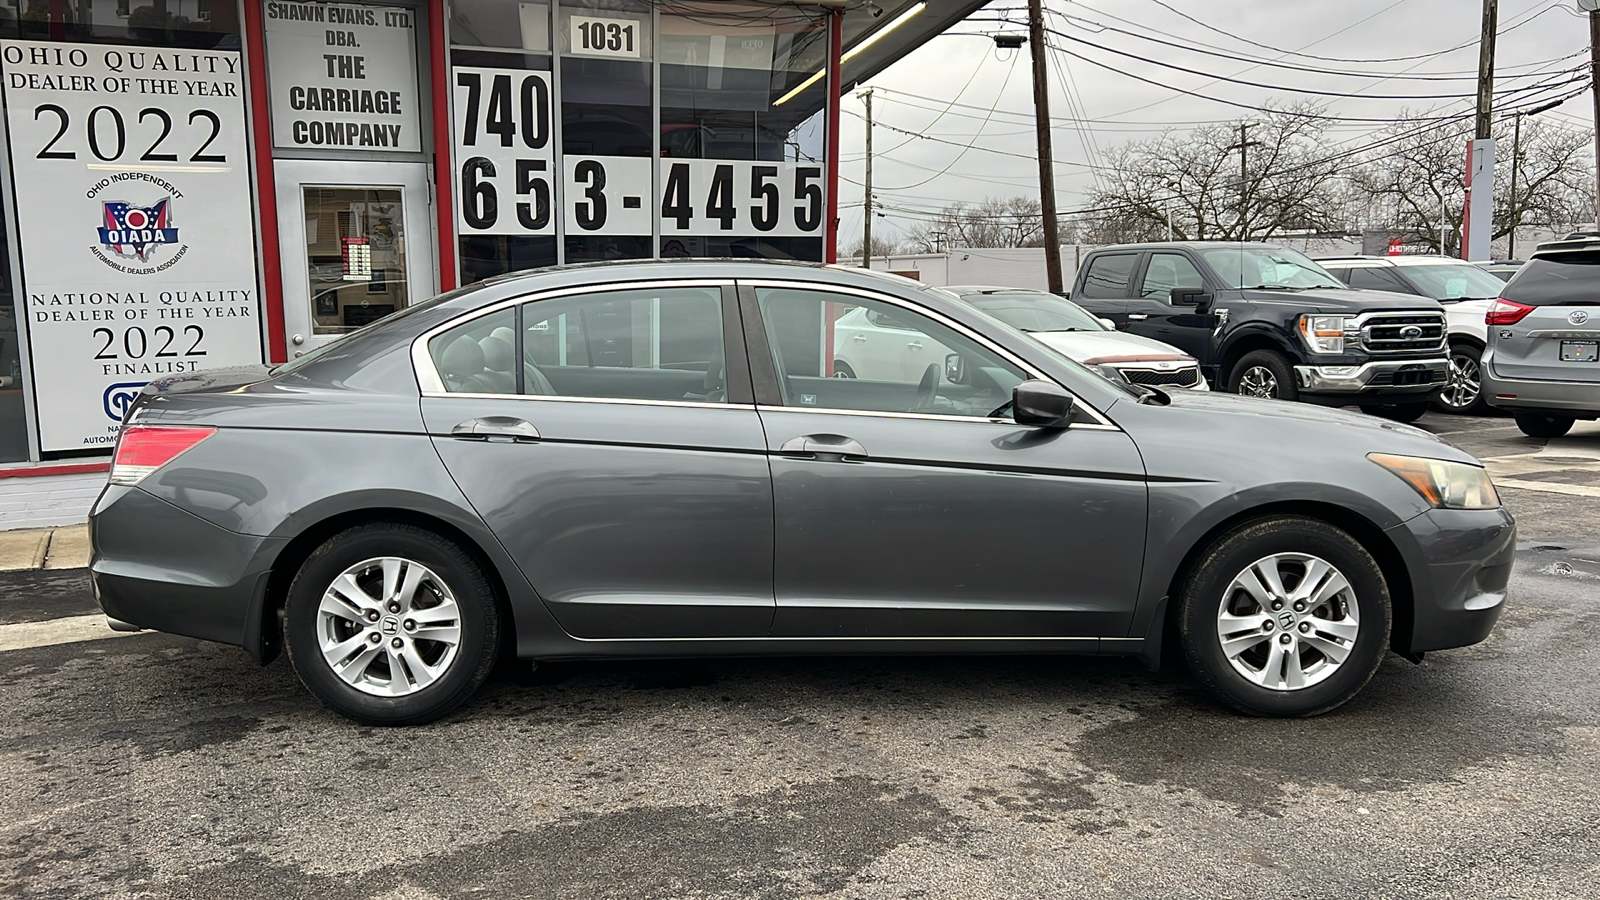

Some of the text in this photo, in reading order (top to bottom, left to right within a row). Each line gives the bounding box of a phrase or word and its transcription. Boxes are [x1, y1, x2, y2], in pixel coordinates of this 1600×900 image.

[267, 2, 413, 29] SHAWN EVANS. LTD.
[325, 29, 361, 48] DBA.
[578, 22, 633, 51] 1031
[4, 45, 240, 74] OHIO QUALITY
[322, 53, 366, 80] THE
[9, 72, 238, 98] DEALER OF THE YEAR
[289, 87, 402, 115] CARRIAGE
[456, 72, 550, 150] 740
[34, 103, 227, 163] 2022
[291, 120, 402, 148] COMPANY
[86, 172, 184, 200] OHIO INDEPENDENT
[108, 229, 166, 243] OIADA
[89, 244, 189, 275] AUTOMOBILE DEALERS ASSOCIATION
[32, 290, 251, 306] NATIONAL QUALITY
[36, 306, 250, 323] DEALER OF THE YEAR
[92, 324, 207, 360] 2022
[102, 360, 200, 376] FINALIST
